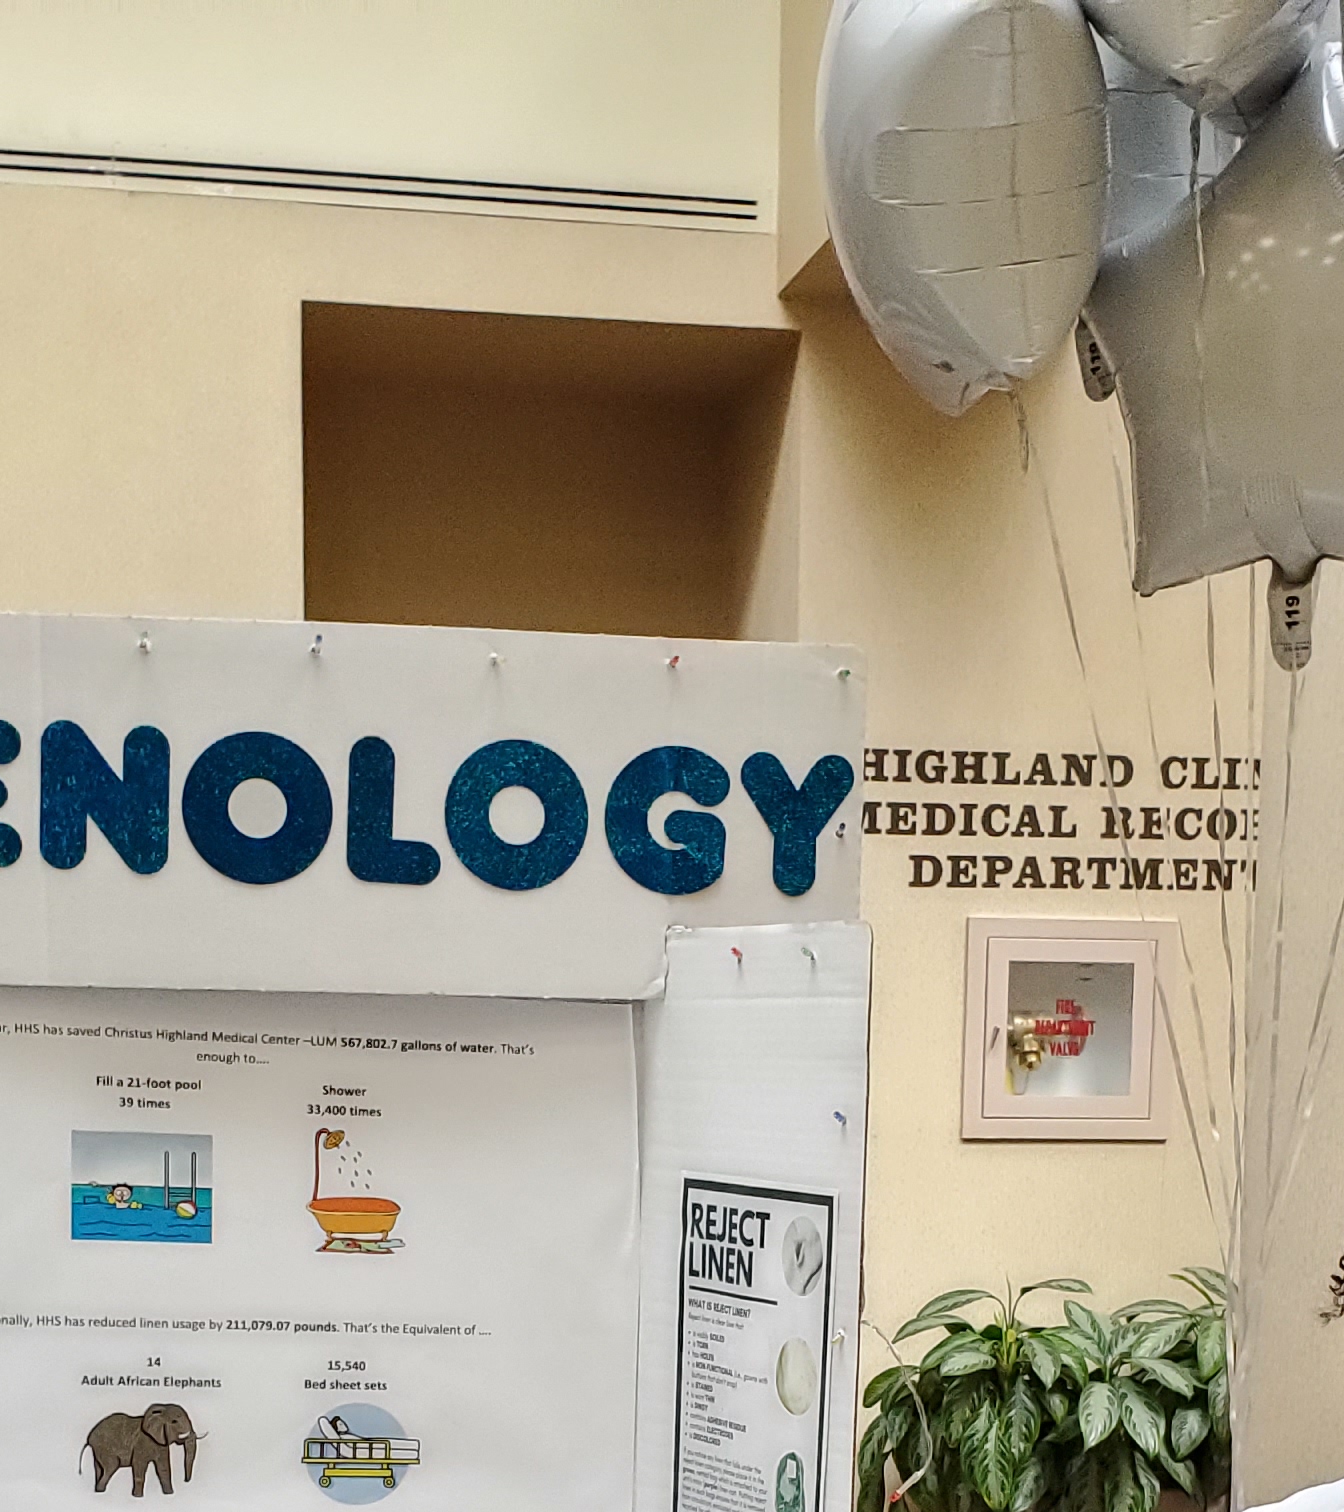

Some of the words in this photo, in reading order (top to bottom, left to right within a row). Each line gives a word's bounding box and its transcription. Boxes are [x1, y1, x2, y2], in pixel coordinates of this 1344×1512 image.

[1285, 595, 1300, 630] 119
[862, 747, 1135, 788] HIGHLAND
[14, 1024, 39, 1035] HHS
[43, 1024, 63, 1036] has
[66, 1026, 101, 1037] saved
[104, 1027, 153, 1040] Christus
[156, 1029, 208, 1043] Highland
[212, 1031, 258, 1044] Medical
[261, 1034, 300, 1046] Center
[341, 1037, 397, 1050] 567,802.7
[401, 1040, 442, 1053] gallons
[445, 1041, 457, 1052] of
[460, 1043, 497, 1054] water.
[196, 1051, 240, 1065] enough
[96, 1076, 113, 1087] Fill
[116, 1079, 123, 1087] a
[127, 1077, 171, 1089] 21-foot
[175, 1079, 202, 1092] pool
[322, 1085, 367, 1097] Shower
[119, 1097, 133, 1107] 39
[137, 1097, 171, 1109] times
[307, 1104, 346, 1117] 33,400
[349, 1106, 382, 1118] times
[690, 1202, 771, 1249] REJECT
[688, 1241, 754, 1288] LINEN
[36, 1316, 61, 1326] HHS
[64, 1315, 85, 1327] has
[88, 1316, 136, 1329] reduced
[139, 1317, 168, 1329] linen
[172, 1320, 205, 1332] usage
[209, 1319, 223, 1332] by
[225, 1320, 290, 1332] 211,079.07
[294, 1321, 340, 1334] pounds.
[381, 1323, 399, 1334] the
[403, 1323, 461, 1336] Equivalent
[464, 1324, 476, 1335] of
[147, 1357, 161, 1367] 14
[327, 1360, 366, 1372] 15,540
[81, 1375, 113, 1386] Adult
[117, 1376, 160, 1387] African
[164, 1376, 222, 1390] Elephants
[304, 1379, 326, 1390] Bed
[329, 1380, 361, 1390] sheet
[364, 1381, 387, 1391] sets
